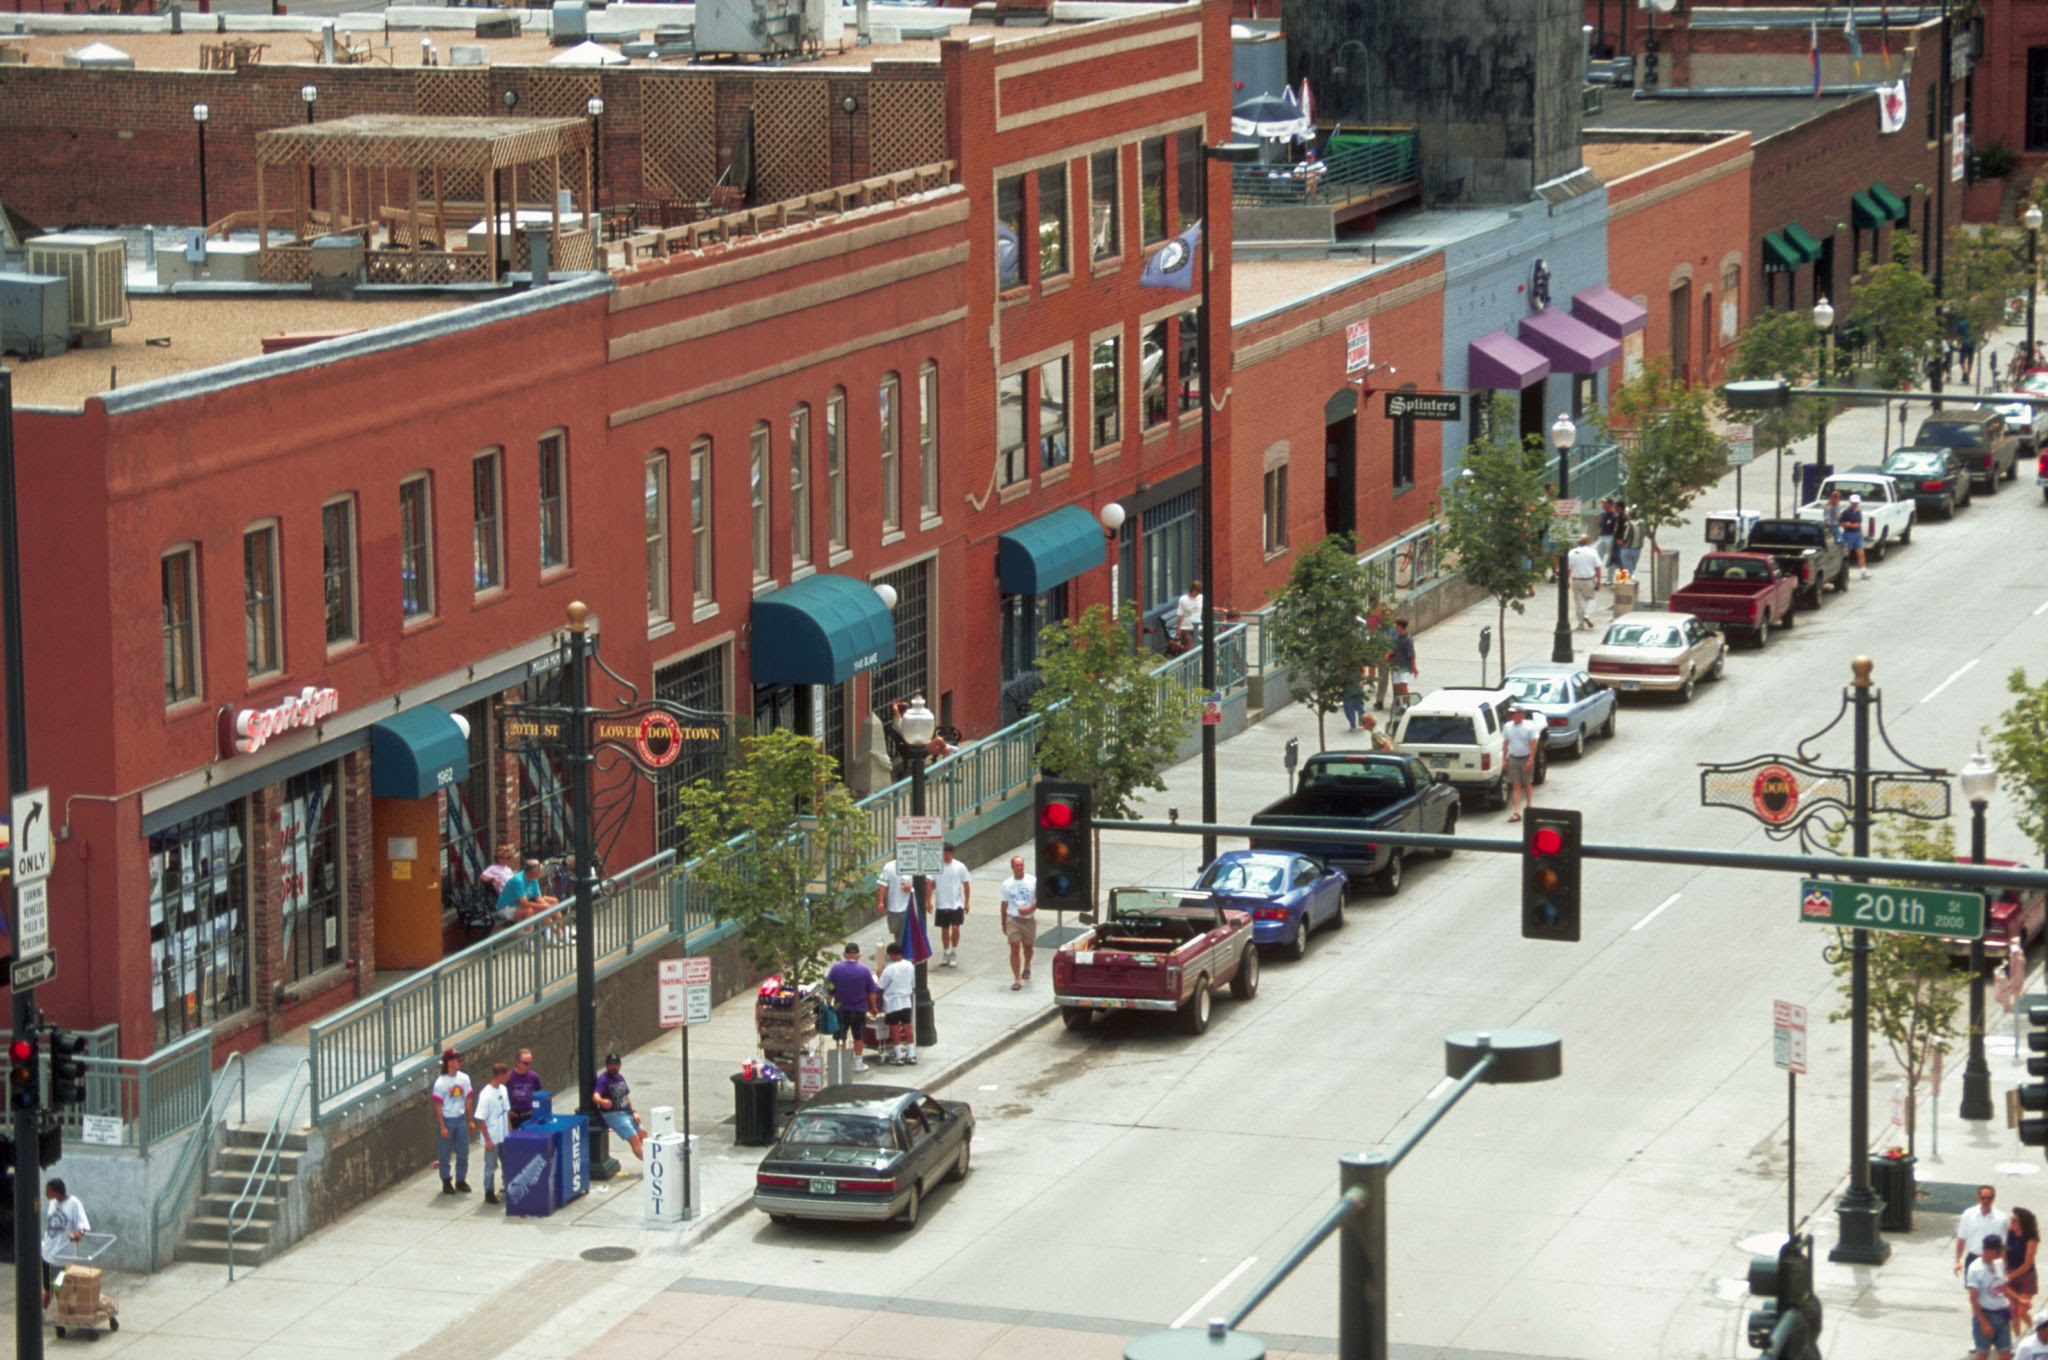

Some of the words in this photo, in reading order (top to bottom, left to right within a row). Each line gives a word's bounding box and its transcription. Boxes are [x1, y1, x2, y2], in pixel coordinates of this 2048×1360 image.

[1389, 396, 1457, 416] Splinters
[236, 686, 338, 753] Sportsfan
[510, 723, 539, 736] 20TH
[544, 724, 560, 736] ST
[600, 725, 642, 738] LOWER
[437, 766, 454, 786] 1962
[19, 851, 46, 875] ONLY
[1854, 893, 1926, 925] 20th
[1948, 900, 1961, 913] St
[23, 920, 38, 934] YIELD
[1934, 914, 1965, 929] 2000
[16, 967, 29, 981] ONE
[31, 962, 45, 975] WAY
[571, 1126, 581, 1192] NEWS
[651, 1142, 664, 1215] POST
